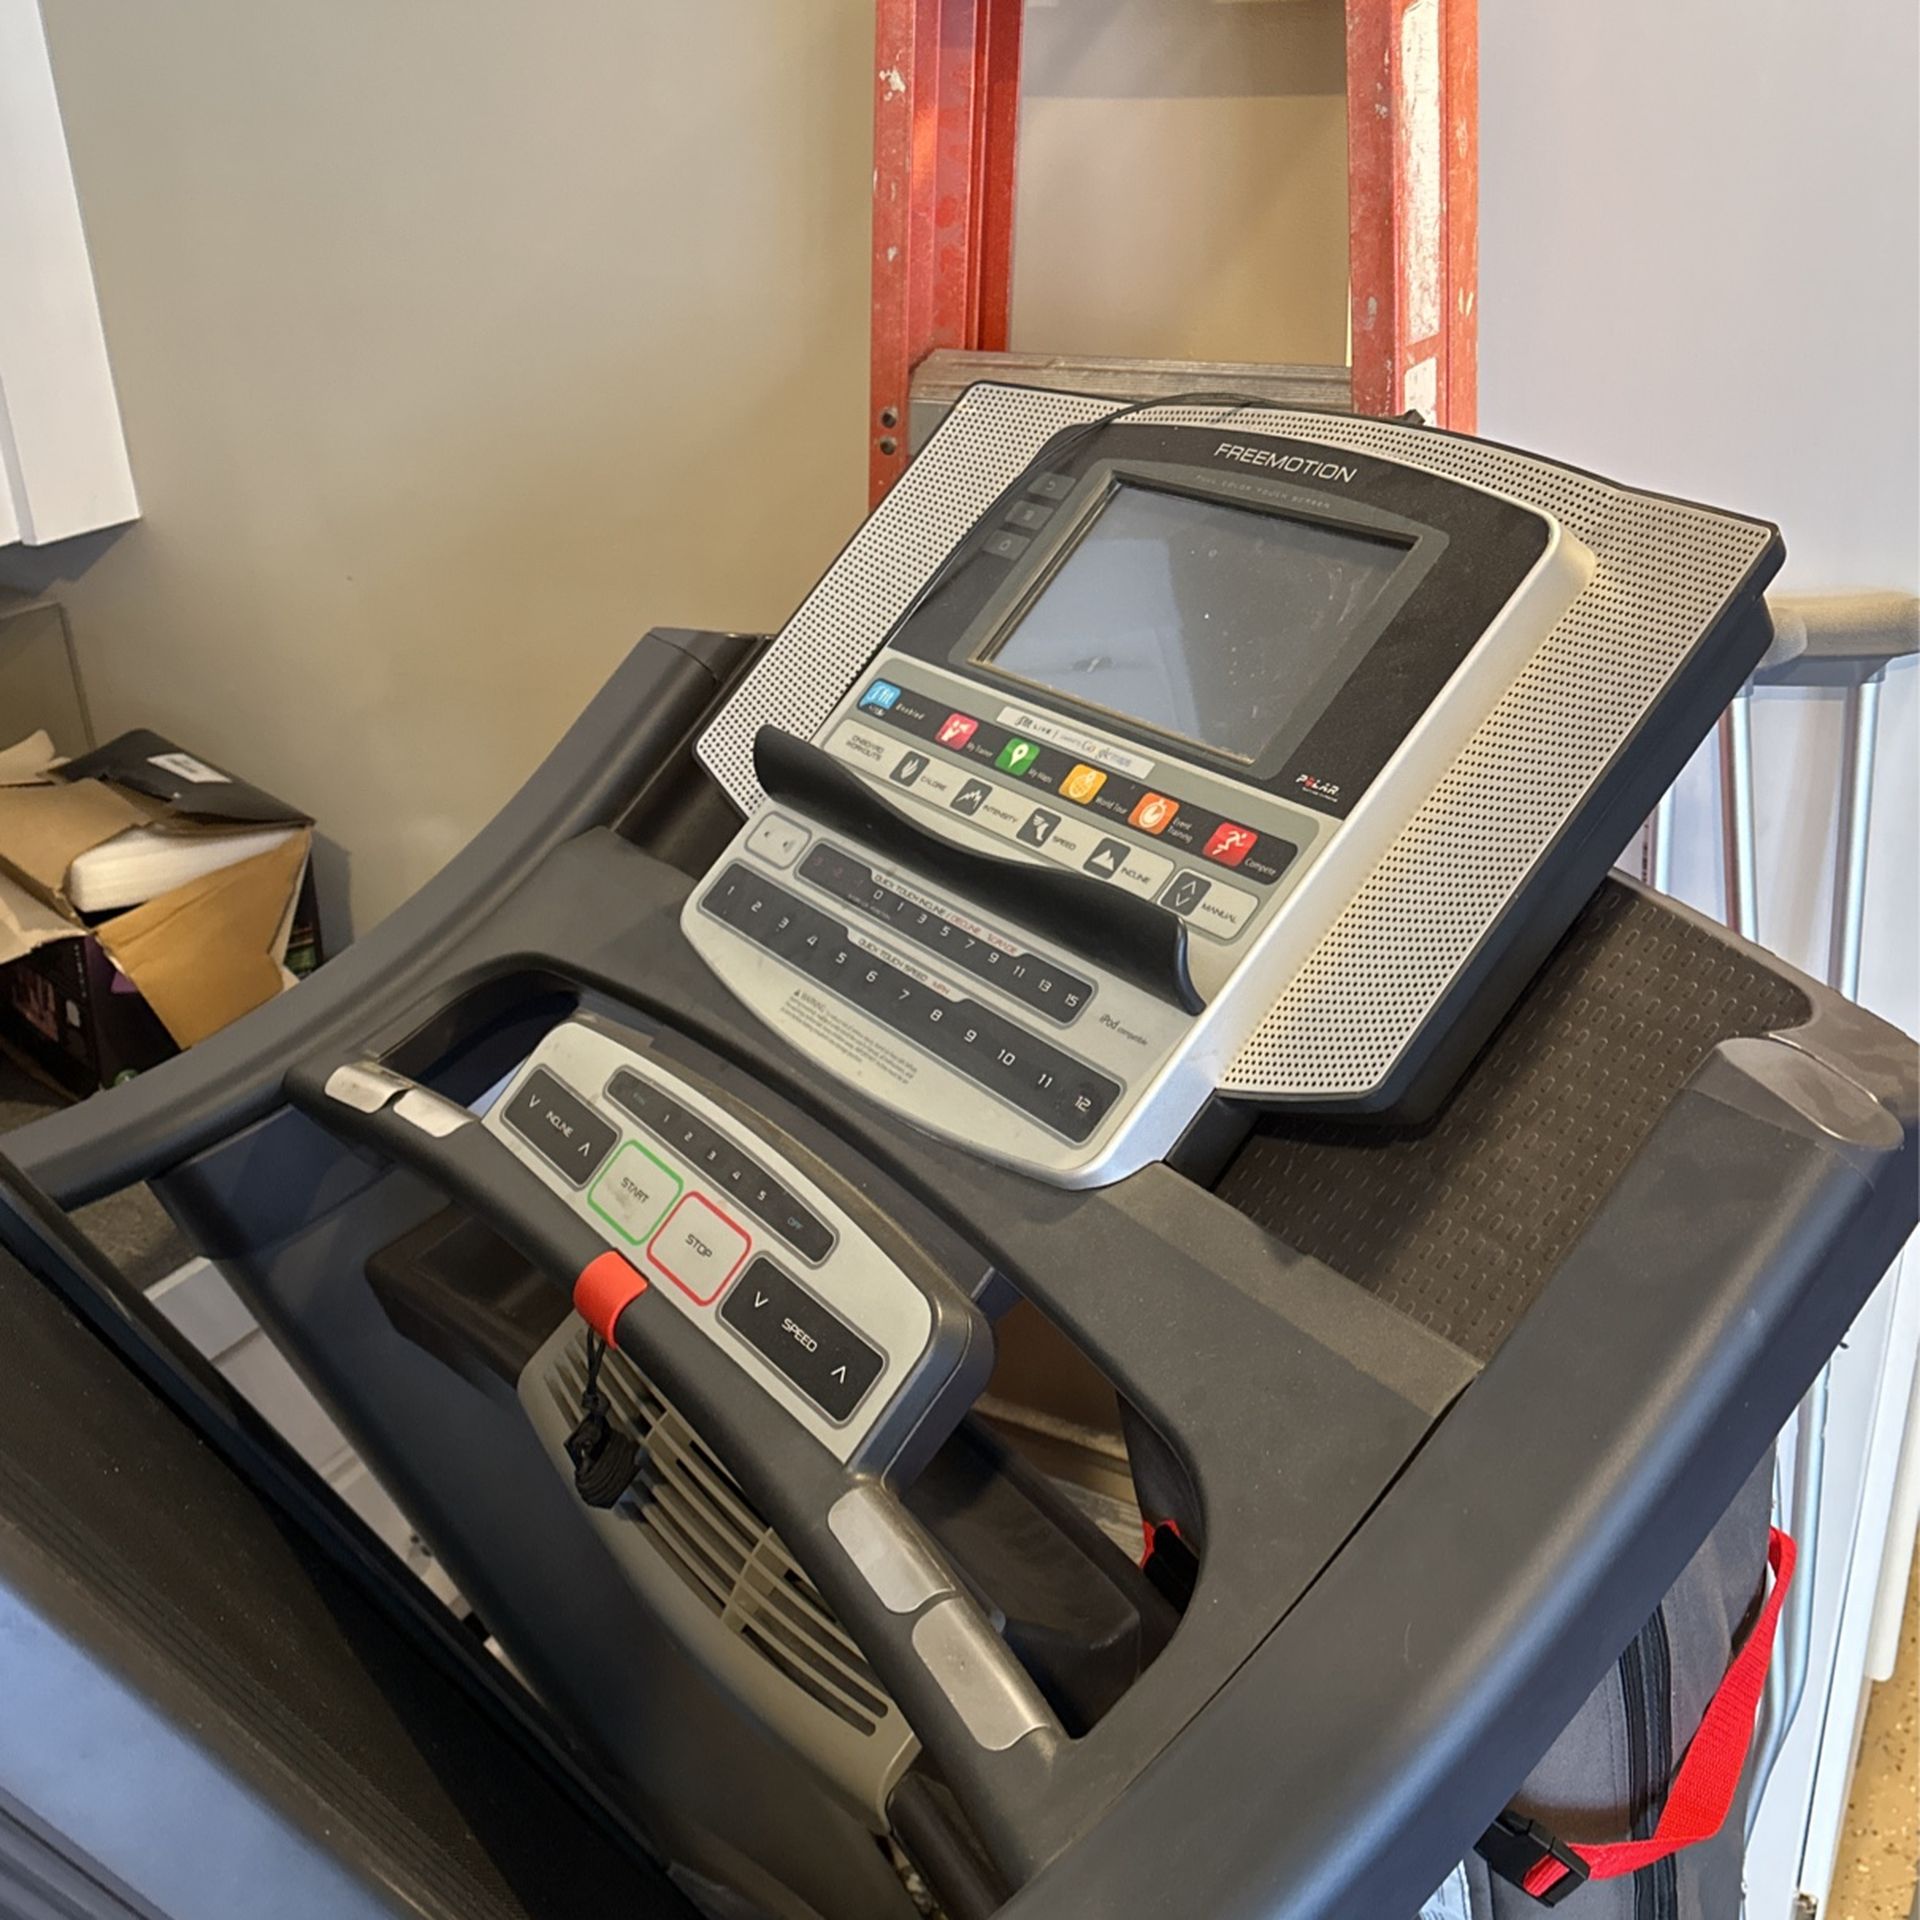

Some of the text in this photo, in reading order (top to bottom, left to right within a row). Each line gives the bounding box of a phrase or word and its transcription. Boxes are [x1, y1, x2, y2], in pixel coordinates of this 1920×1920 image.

[1213, 443, 1357, 483] FREEMOTION
[1296, 774, 1340, 795] POLAR
[983, 804, 1018, 824] INTENSITY
[1172, 817, 1192, 830] Event
[1052, 835, 1077, 851] SPEED
[1167, 826, 1193, 844] Training
[1121, 867, 1151, 885] INCLINE
[1245, 858, 1277, 876] Compete
[874, 873, 894, 889] QUICK
[895, 884, 918, 902] TOUCH
[919, 897, 946, 916] INCLINE
[951, 914, 982, 935] DECLINE
[1201, 901, 1238, 924] MANUAL
[858, 938, 878, 953] QUICK
[880, 949, 903, 967] TOUCH
[903, 963, 929, 982] SPEED
[873, 889, 884, 900] 0
[897, 902, 904, 911] 1
[917, 913, 928, 924] 3
[940, 925, 951, 937] 5
[964, 938, 976, 949] 7
[987, 952, 1000, 964] 9
[1012, 965, 1026, 978] 11
[1038, 978, 1053, 993] 13
[1064, 993, 1080, 1007] 15
[727, 885, 1092, 1113] 1 2 3 4 5 6 7 8 9 10 11 12
[1099, 1014, 1120, 1030] iPod
[545, 1111, 574, 1138] INCLINE
[663, 1114, 804, 1231] 1 2 3 4 5 OFF
[620, 1176, 650, 1204] START
[685, 1233, 713, 1258] STOP
[781, 1317, 818, 1353] SPEED
